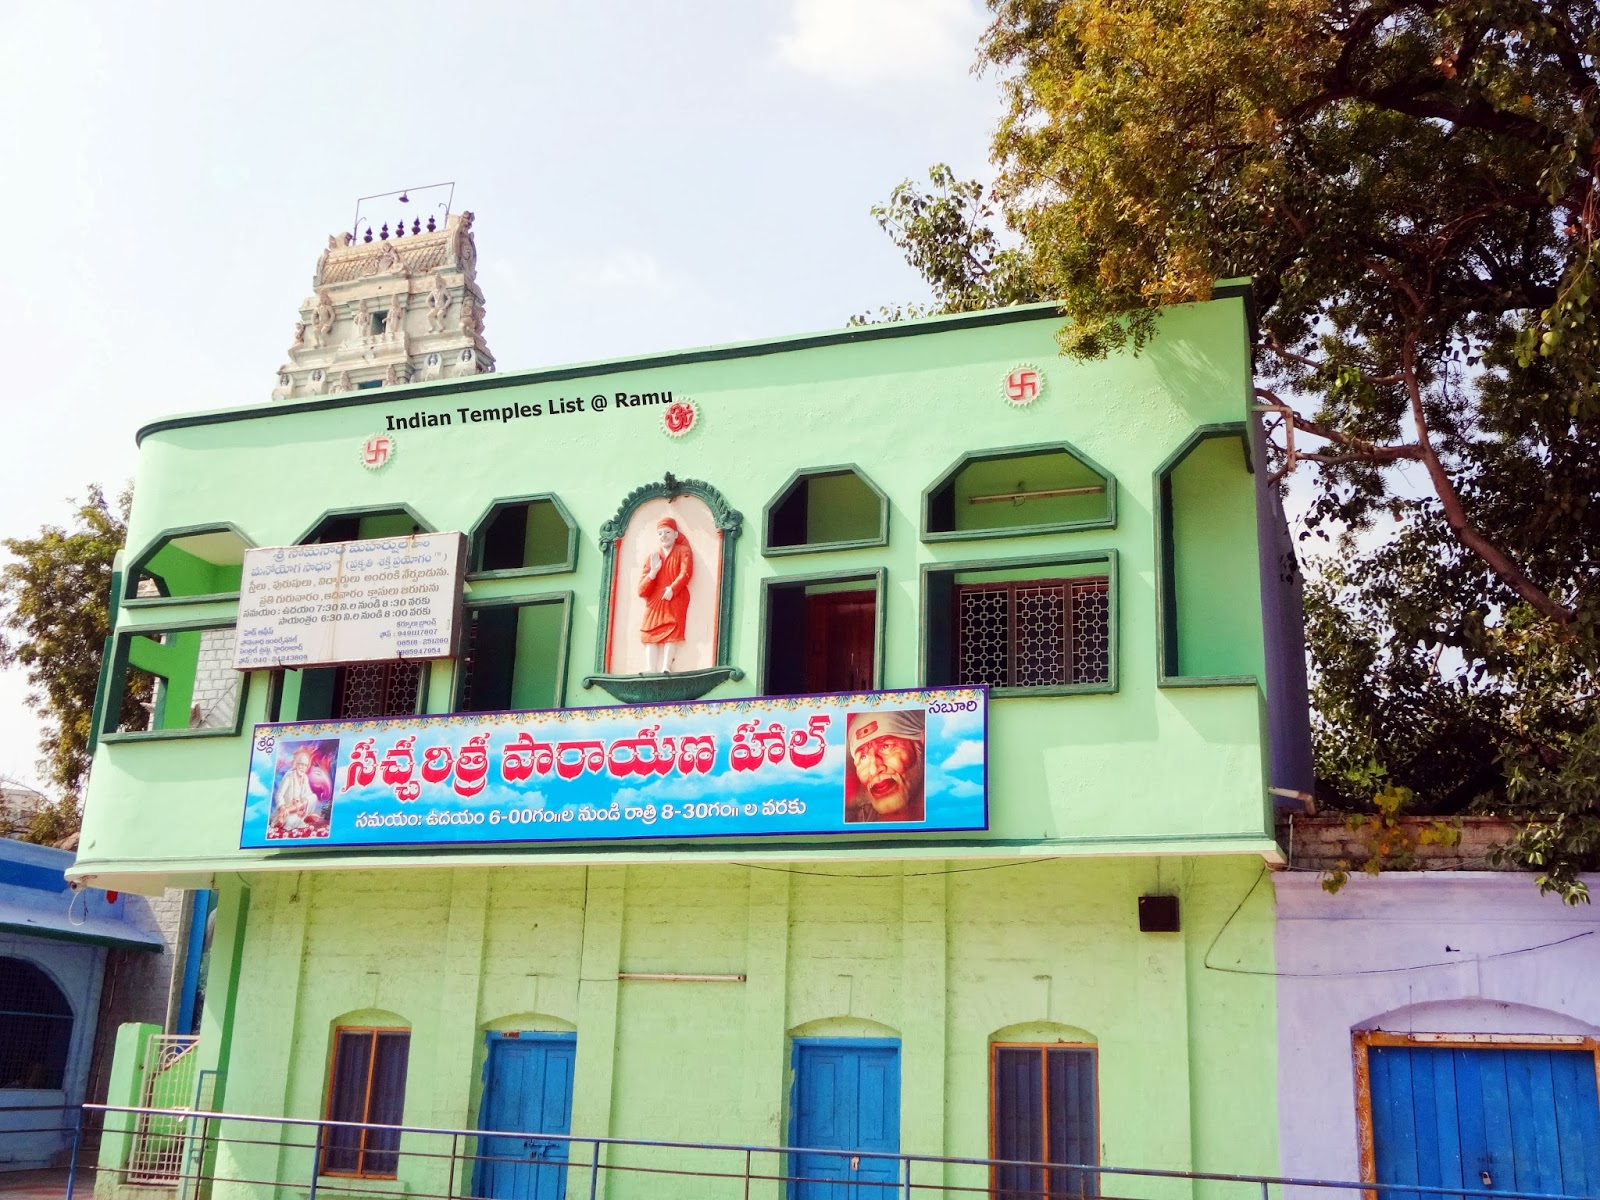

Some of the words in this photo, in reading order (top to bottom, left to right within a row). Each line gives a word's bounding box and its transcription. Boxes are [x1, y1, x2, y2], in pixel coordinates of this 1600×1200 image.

[316, 603, 338, 612] 7:30
[320, 613, 343, 623] 6:30
[928, 699, 978, 715] సబూరి
[341, 732, 491, 803] సచ్చరిత్ర
[502, 723, 717, 784] పారాయణ
[728, 714, 832, 774] హాల్
[425, 809, 485, 826] ఉదయం
[577, 801, 621, 822] నుండి
[624, 804, 657, 825] రాత్రి
[761, 798, 807, 816] వరకు
